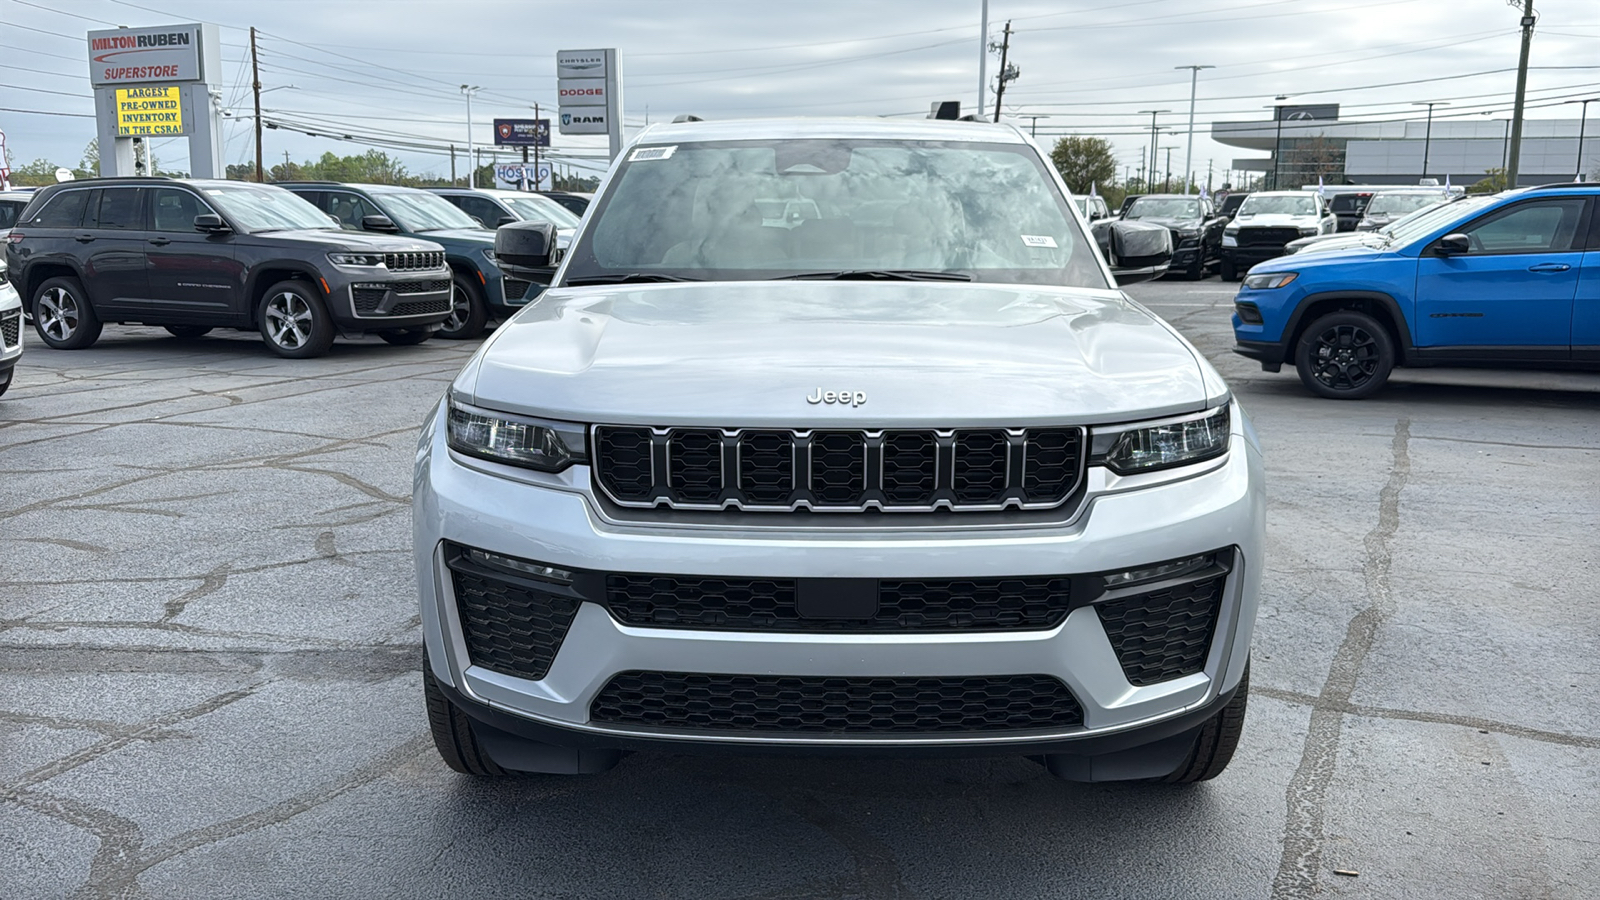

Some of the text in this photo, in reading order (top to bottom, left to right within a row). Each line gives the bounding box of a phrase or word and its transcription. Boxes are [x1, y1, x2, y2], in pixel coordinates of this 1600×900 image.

[92, 33, 190, 50] MILTON RUBEN
[104, 65, 178, 80] SUPERSTORE
[127, 87, 169, 98] LARGEST
[560, 88, 604, 97] DODGE
[121, 100, 177, 110] PRE-OWNED
[122, 113, 178, 122] INVENTORY
[573, 116, 604, 124] RAM
[120, 126, 130, 134] IN
[132, 126, 152, 134] THE
[497, 168, 549, 178] HOSTIO
[806, 387, 867, 408] Jeep
